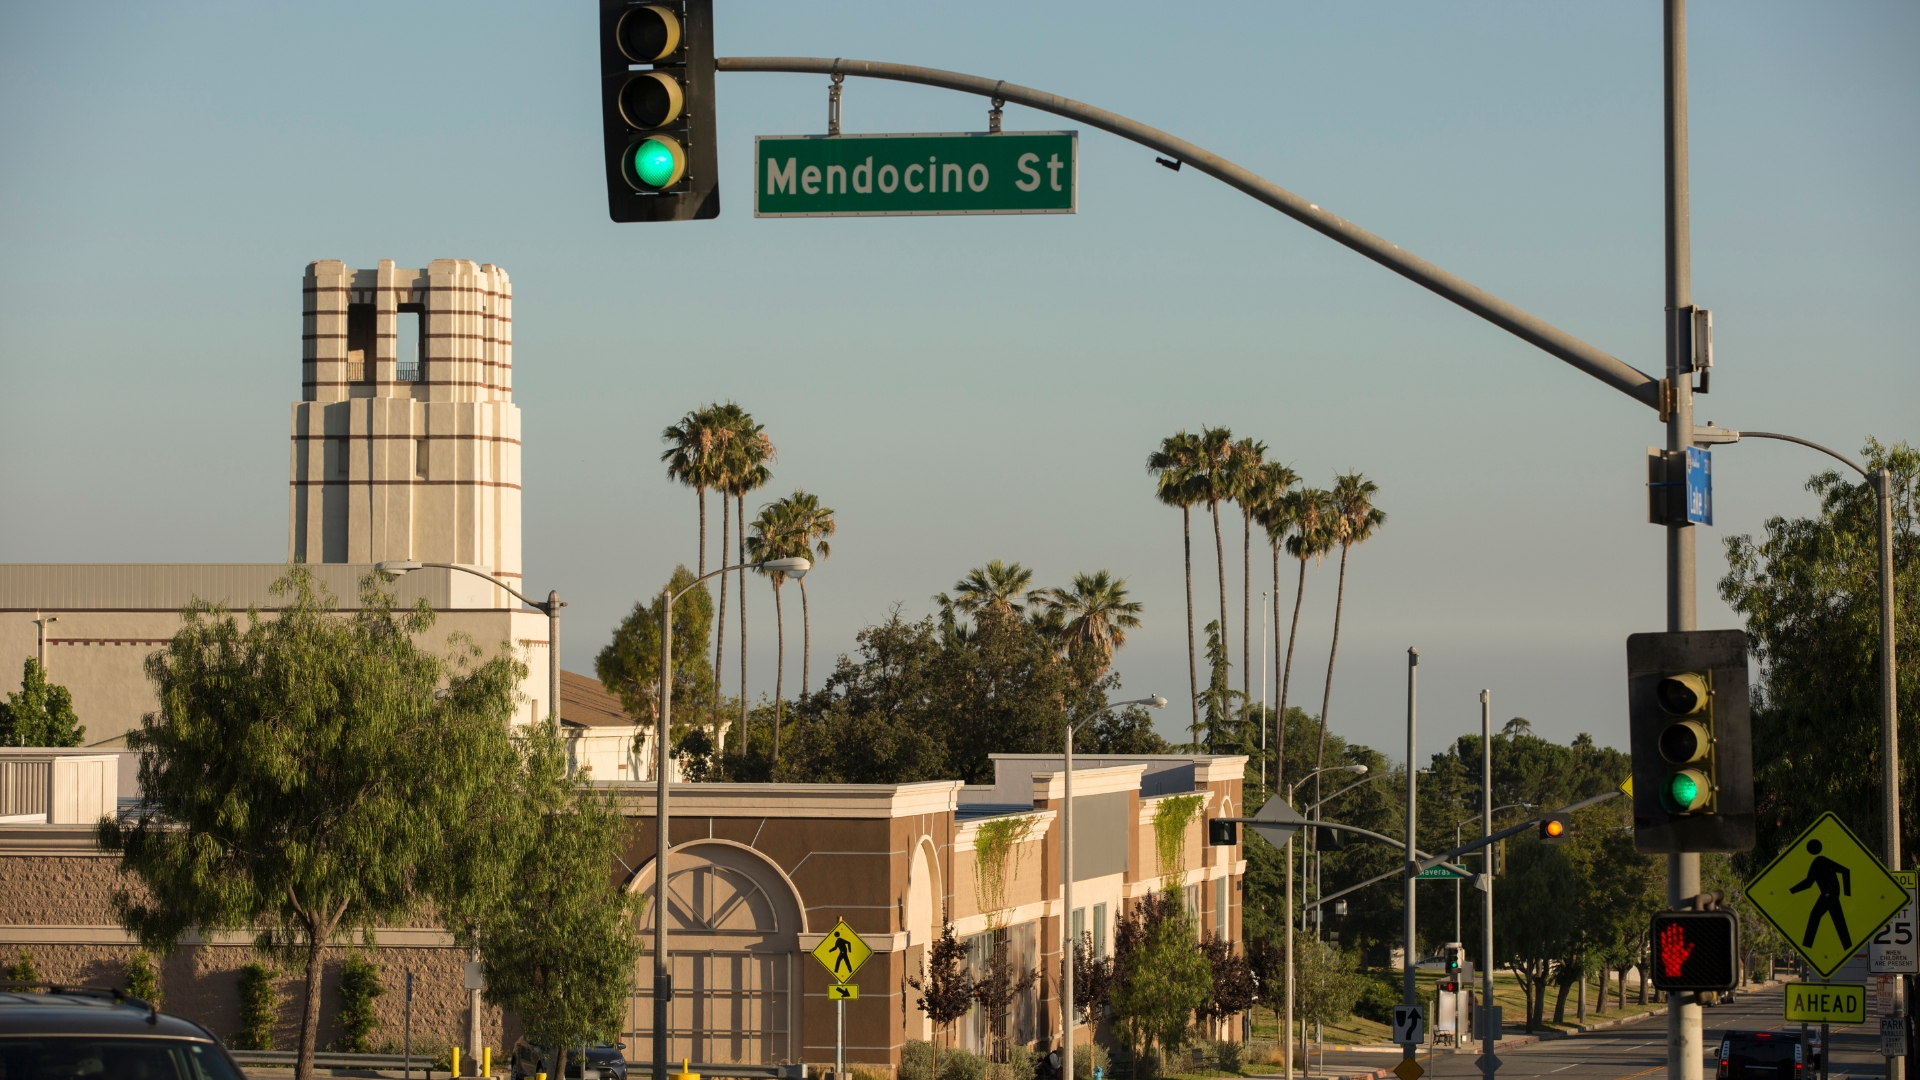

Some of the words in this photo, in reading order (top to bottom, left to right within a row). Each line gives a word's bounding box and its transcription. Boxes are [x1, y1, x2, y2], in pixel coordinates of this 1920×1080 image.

[767, 155, 990, 195] Mendocino
[1014, 152, 1064, 192] St
[1873, 922, 1913, 945] 25
[1793, 993, 1857, 1013] AHEAD
[1881, 1020, 1905, 1030] PARK
